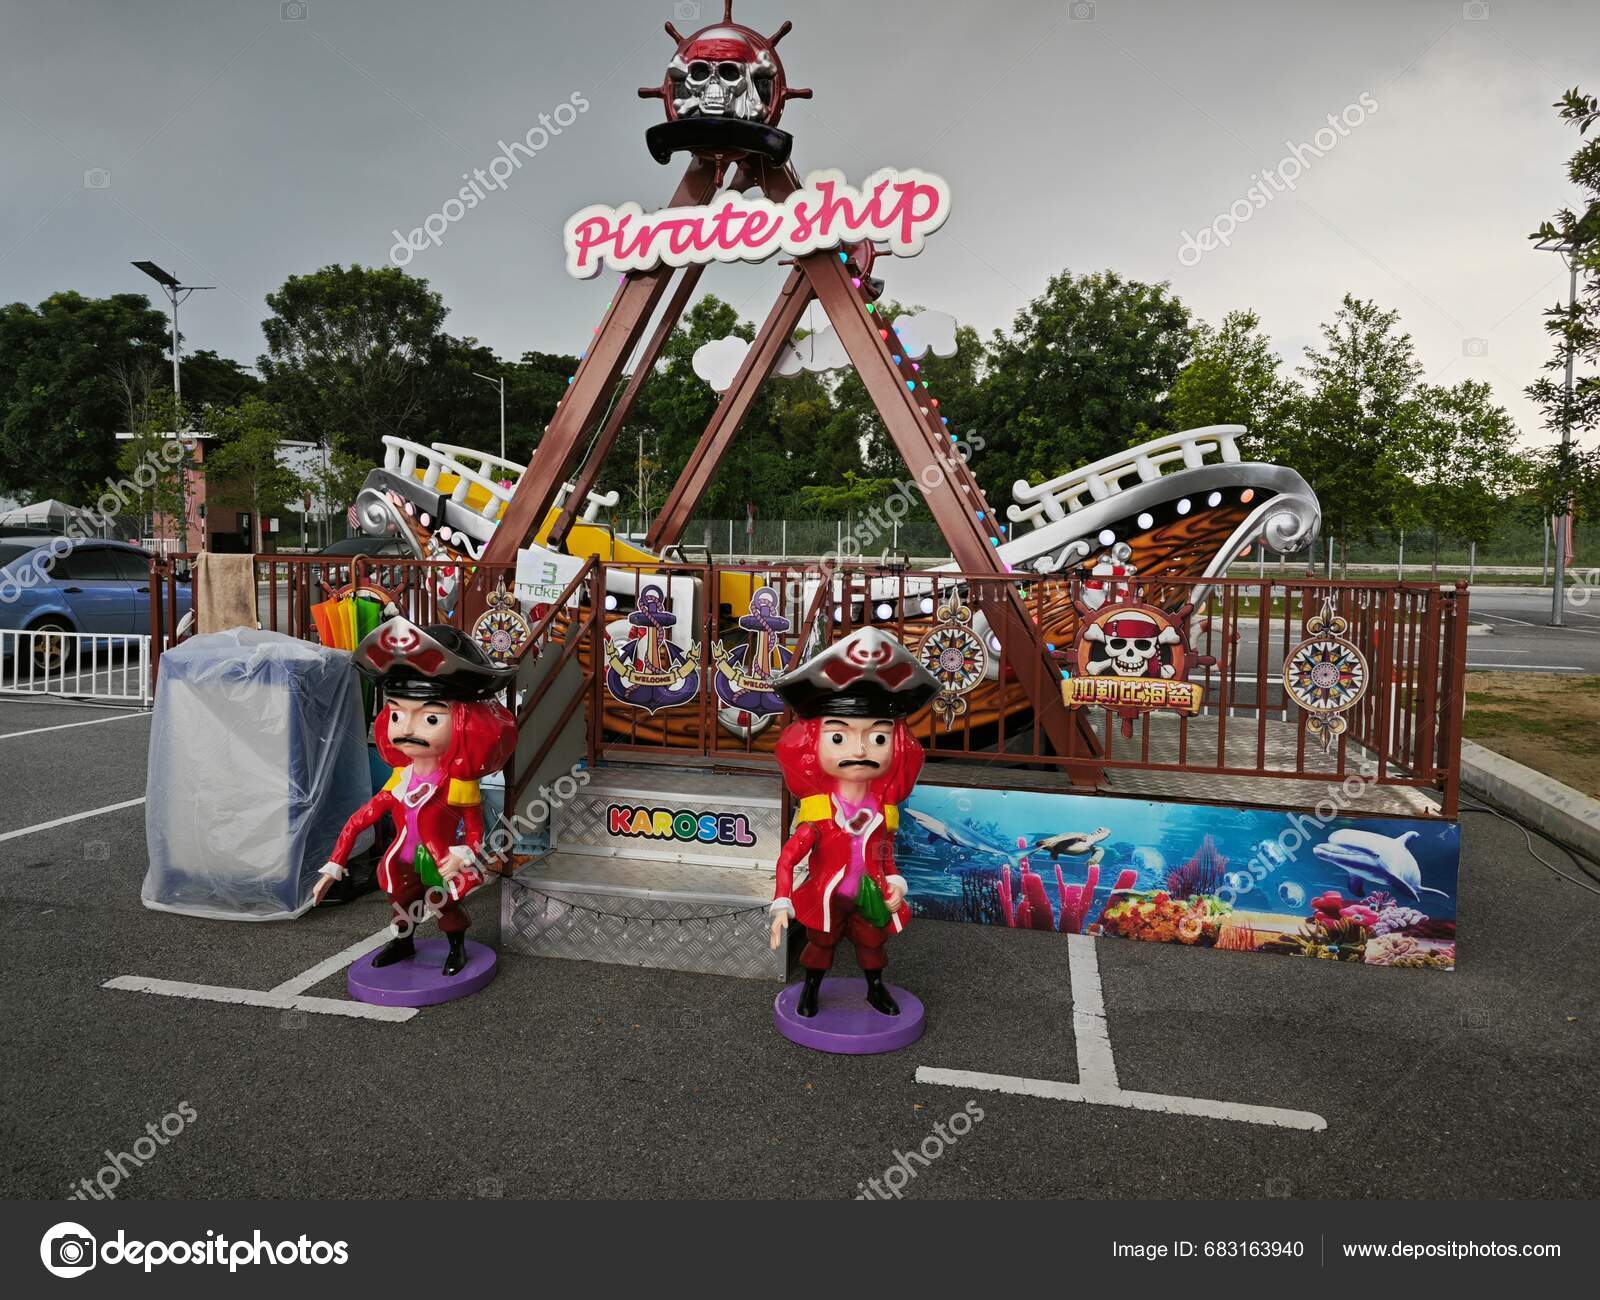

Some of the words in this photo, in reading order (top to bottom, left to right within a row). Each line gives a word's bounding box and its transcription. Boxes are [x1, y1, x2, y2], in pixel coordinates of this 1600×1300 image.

[575, 202, 782, 267] Pirate
[790, 180, 940, 244] ship
[541, 561, 558, 584] 3
[527, 584, 563, 599] TOKE
[634, 675, 671, 683] WELCOME
[743, 679, 774, 689] WELCO
[608, 804, 756, 846] KAROSEL
